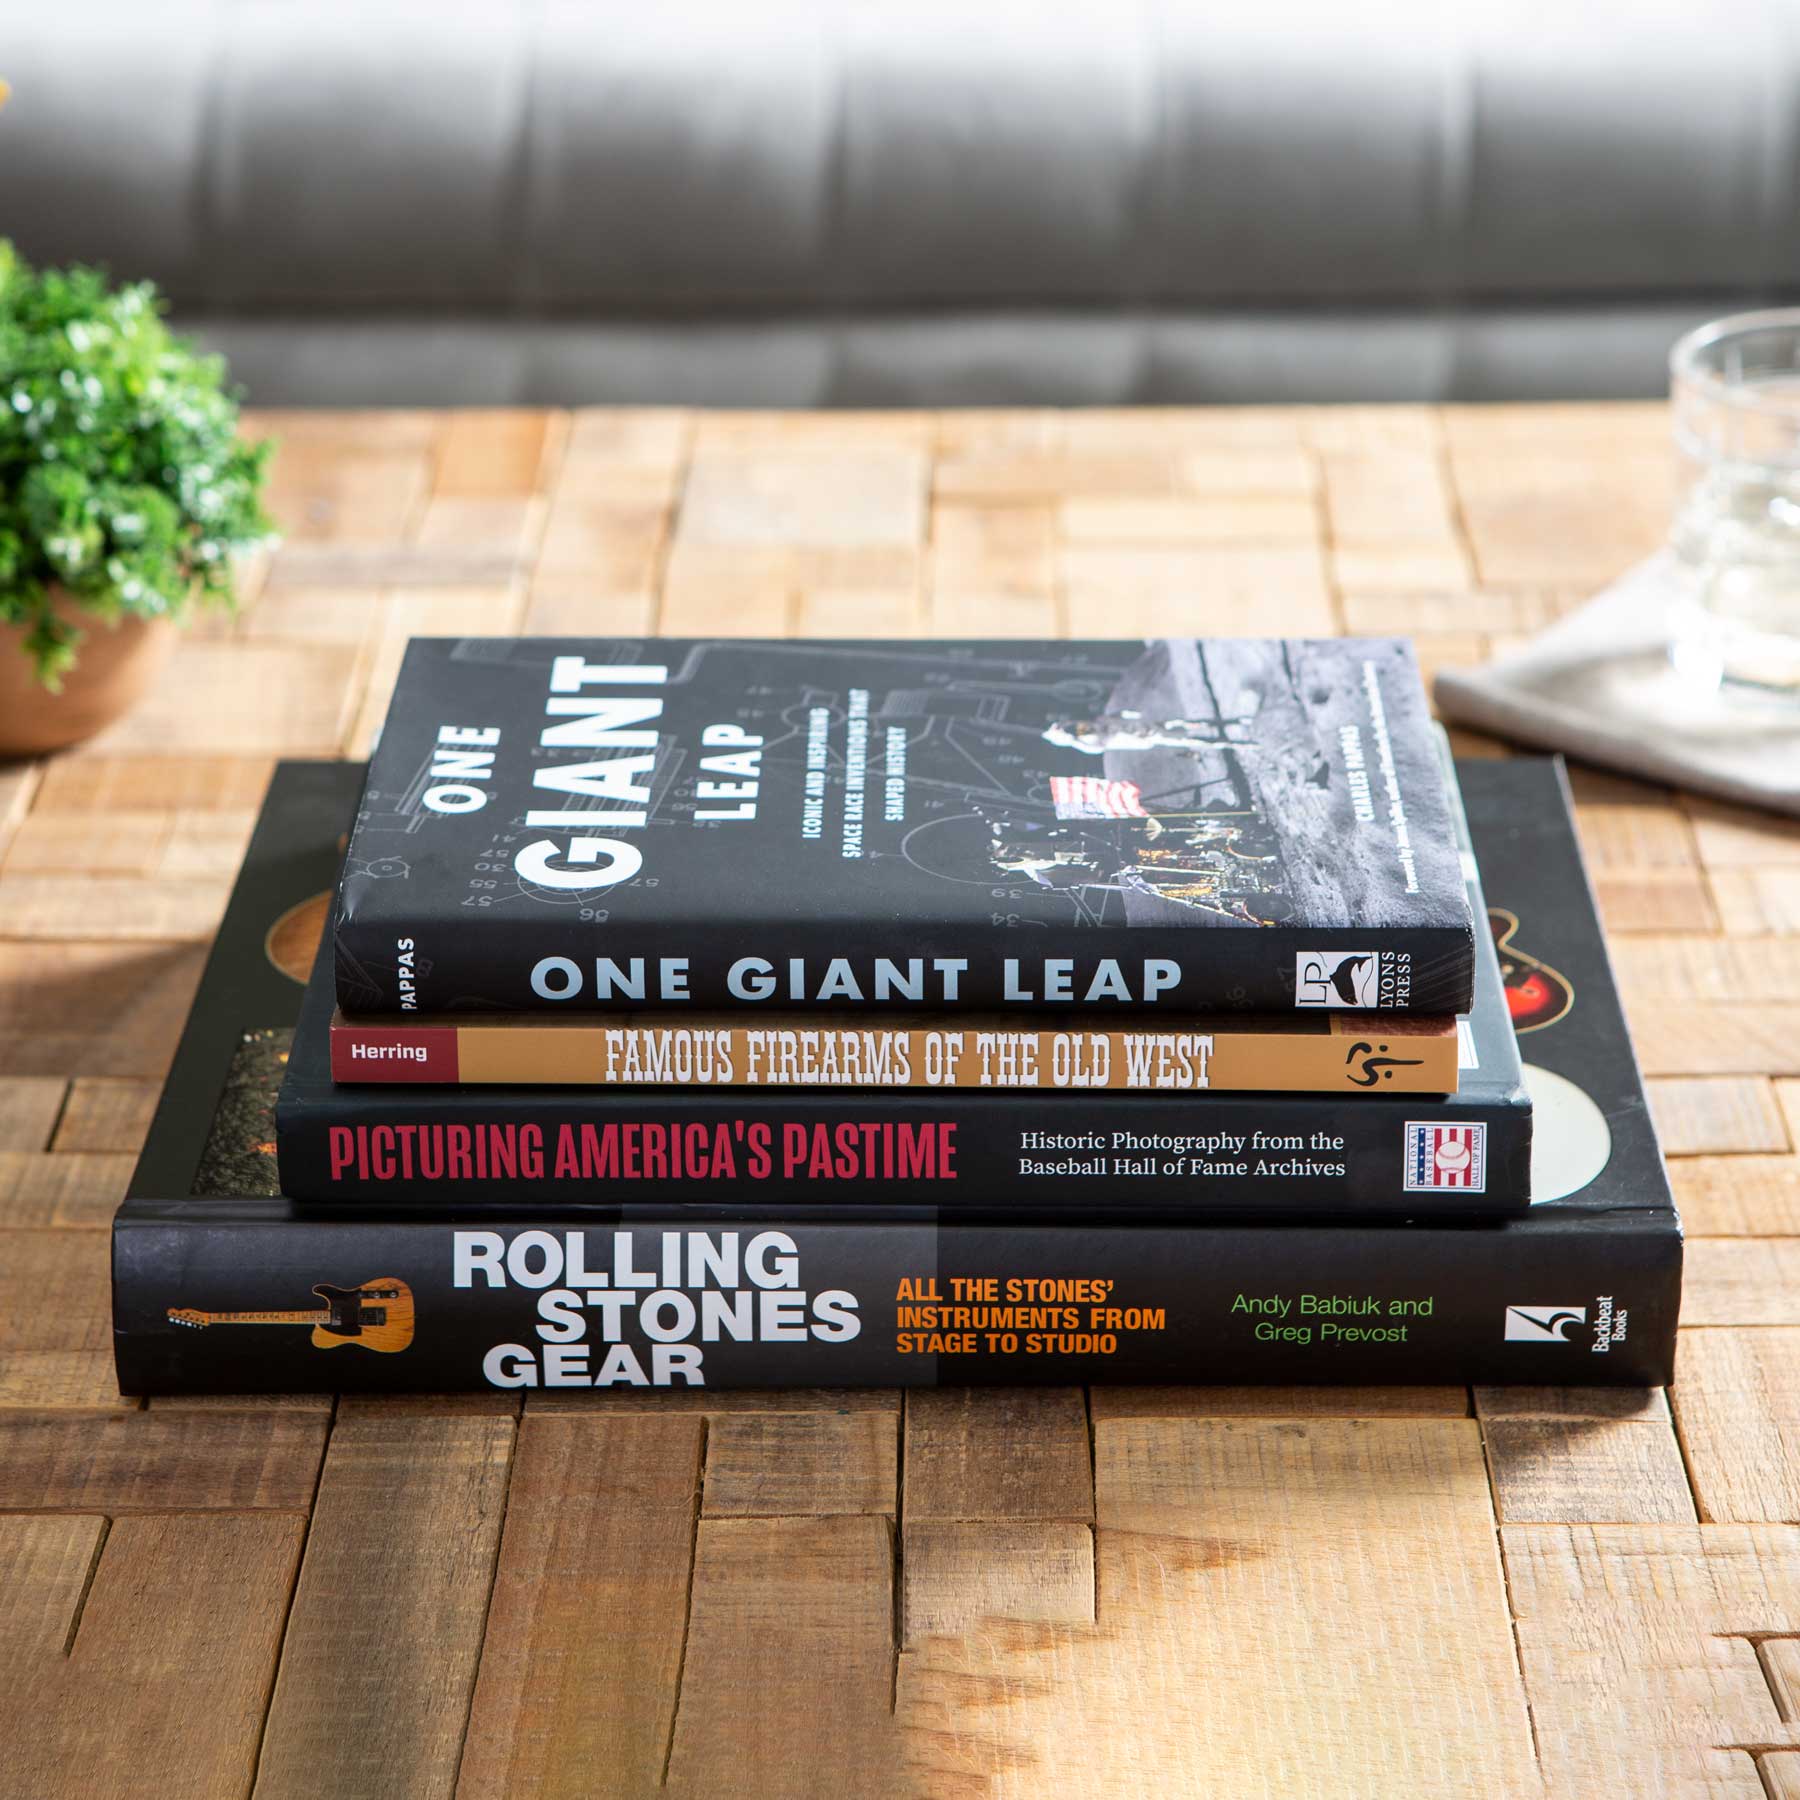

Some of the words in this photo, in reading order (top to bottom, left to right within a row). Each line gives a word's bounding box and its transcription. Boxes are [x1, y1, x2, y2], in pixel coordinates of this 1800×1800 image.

[807, 707, 829, 769] INSPIRING
[846, 719, 867, 790] INVENTIONS
[886, 726, 906, 775] HISTORY
[1338, 725, 1364, 769] PAPPAS
[422, 725, 501, 813] ONE
[514, 656, 668, 889] GIANT
[694, 723, 763, 820] LEAP
[805, 771, 825, 796] AND
[844, 793, 864, 821] RACE
[885, 778, 905, 821] SHAPED
[1347, 771, 1375, 821] CHARLES
[802, 798, 824, 838] ICONIC
[480, 848, 509, 858] 57
[492, 834, 516, 843] 41
[842, 823, 863, 858] SPACE
[468, 878, 497, 888] 55
[473, 862, 507, 872] 30
[629, 878, 660, 887] 57
[460, 895, 493, 906] 57
[991, 888, 1023, 899] 39
[579, 908, 610, 923] 56
[991, 912, 1020, 927] 34
[398, 937, 417, 1010] PAPPAS
[530, 956, 690, 1000] ONE
[727, 956, 968, 1001] GIANT
[1004, 958, 1182, 1001] LEAP
[1380, 951, 1395, 1008] LYONS
[1396, 953, 1411, 1007] PRESS
[351, 1044, 427, 1062] Herring
[605, 1029, 733, 1083] FAMOUS
[746, 1029, 911, 1084] FIREARMS
[925, 1031, 963, 1085] OF
[976, 1032, 1039, 1086] THE
[1052, 1033, 1111, 1087] OLD
[1124, 1034, 1213, 1089] WEST
[329, 1124, 544, 1181] PICTURING
[554, 1120, 772, 1179] AMERICA'S
[783, 1122, 958, 1180] PASTIME
[1020, 1131, 1106, 1150] Historic
[1111, 1131, 1247, 1154] Photography
[1252, 1131, 1308, 1150] from
[1310, 1132, 1344, 1150] the
[1410, 1127, 1418, 1186] NATIONAL
[1472, 1153, 1480, 1164] OF
[1019, 1158, 1107, 1176] Baseball
[1113, 1158, 1157, 1176] Hall
[1163, 1158, 1187, 1176] of
[1190, 1158, 1248, 1177] Fame
[1253, 1158, 1346, 1177] Archives
[1472, 1165, 1480, 1187] HALL
[453, 1230, 800, 1289] ROLLING
[896, 1278, 943, 1301] ALL
[950, 1278, 999, 1302] THE
[1231, 1294, 1292, 1319] Andy
[1301, 1295, 1381, 1316] Babiuk
[1388, 1296, 1434, 1317] and
[535, 1289, 862, 1343] STONES
[896, 1307, 1080, 1329] INSTRUMENTS
[1090, 1308, 1166, 1330] FROM
[1592, 1296, 1613, 1352] Backbeat
[1611, 1310, 1628, 1341] Books
[896, 1333, 977, 1354] STAGE
[985, 1333, 1018, 1354] TO
[1026, 1333, 1118, 1354] STUDIO
[1254, 1322, 1312, 1344] Greg
[1320, 1324, 1408, 1343] Prevost
[482, 1343, 705, 1388] GEAR
